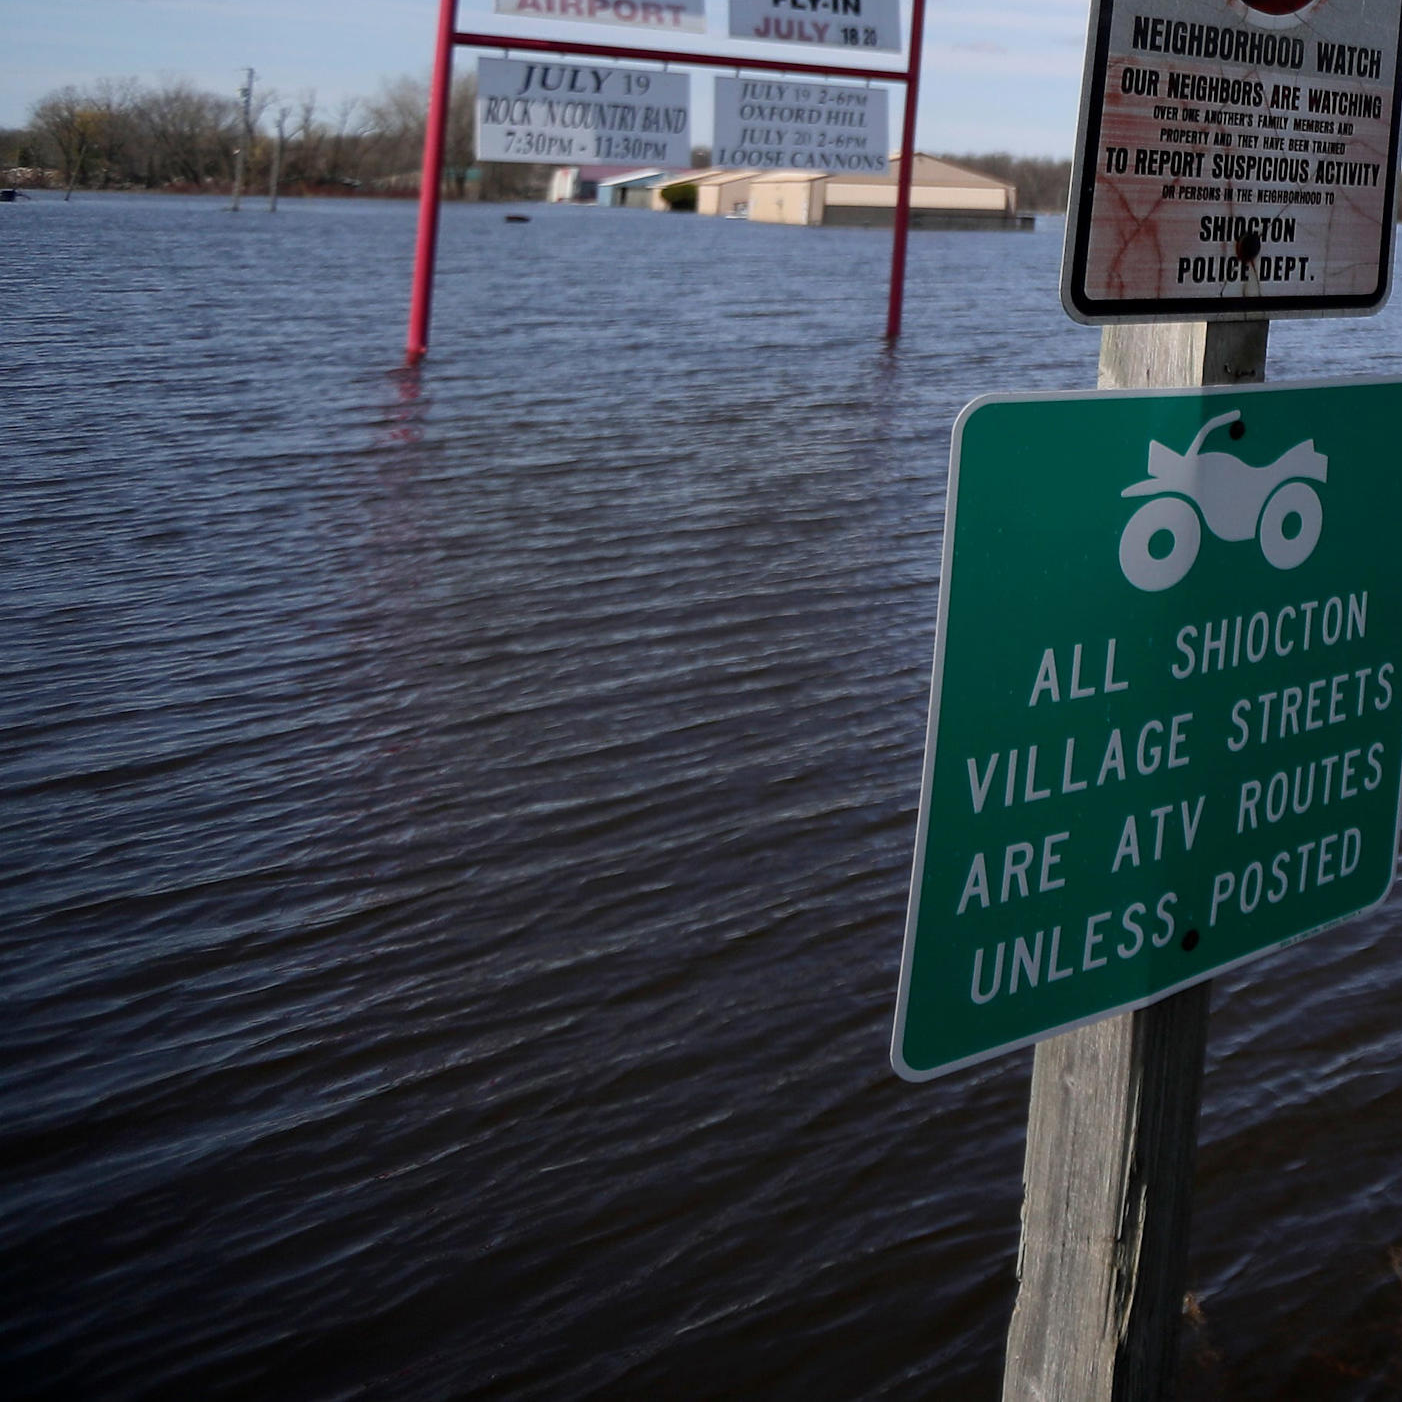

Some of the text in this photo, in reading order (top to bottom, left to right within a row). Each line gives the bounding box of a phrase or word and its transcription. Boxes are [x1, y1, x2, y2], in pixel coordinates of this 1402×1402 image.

[753, 16, 830, 43] JULY
[1132, 16, 1382, 79] NEIGHBORHOOD WATCH
[517, 65, 651, 96] JULY 19
[740, 83, 789, 102] JULY
[1121, 67, 1382, 119] OUR NEIGHBORS ARE WATCHING
[484, 97, 532, 126] ROCK
[561, 101, 639, 132] COUNTRY
[641, 106, 687, 134] BAND
[739, 105, 867, 128] OXFORD HILL
[1153, 105, 1353, 136] OVER ONE ANOTHER'S FAMILY MEMBERS AND
[504, 131, 573, 156] 7:30PM
[594, 135, 667, 160] 11:30PM
[739, 128, 787, 148] JULY
[1160, 128, 1345, 155] PROPERTY AND THEY HAVE BEEN TRAINED
[718, 148, 885, 171] LOOSE CANNONS
[1105, 146, 1381, 187] TO REPORT SUSPICIOUS ACTIVITY
[1162, 186, 1335, 205] OR PERSONS IN THE NEIGHBORHOOD TO
[1199, 215, 1296, 243] SHIOCTON
[1177, 257, 1315, 283] POLICE DEPT.
[1029, 591, 1368, 707] ALL SHIOCTON
[966, 662, 1395, 814] VILLAGE STREETS
[955, 742, 1385, 915] ARE ATV ROUTES
[970, 827, 1362, 1005] UNLESS POSTED
